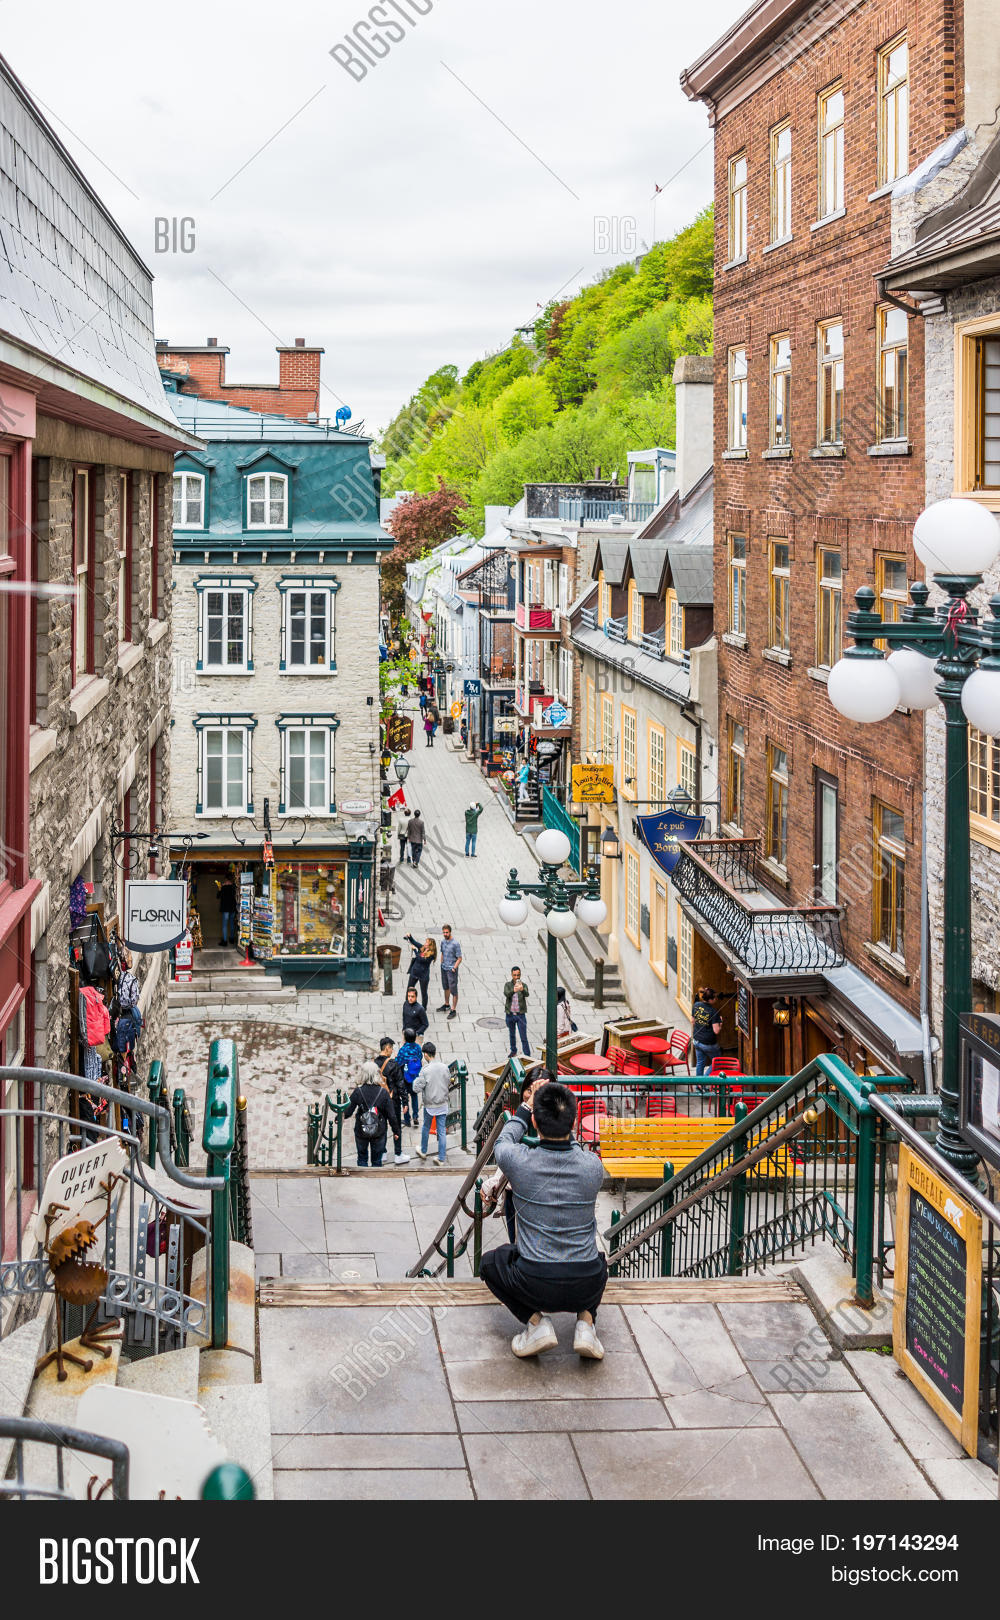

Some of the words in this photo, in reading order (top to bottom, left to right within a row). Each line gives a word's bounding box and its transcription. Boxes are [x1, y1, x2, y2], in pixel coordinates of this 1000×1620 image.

[656, 822, 668, 830] Le
[669, 820, 685, 831] pub
[130, 909, 181, 922] FLORIN
[968, 1015, 979, 1034] LE
[61, 1152, 108, 1185] OUVERT
[64, 1175, 96, 1201] OPEN
